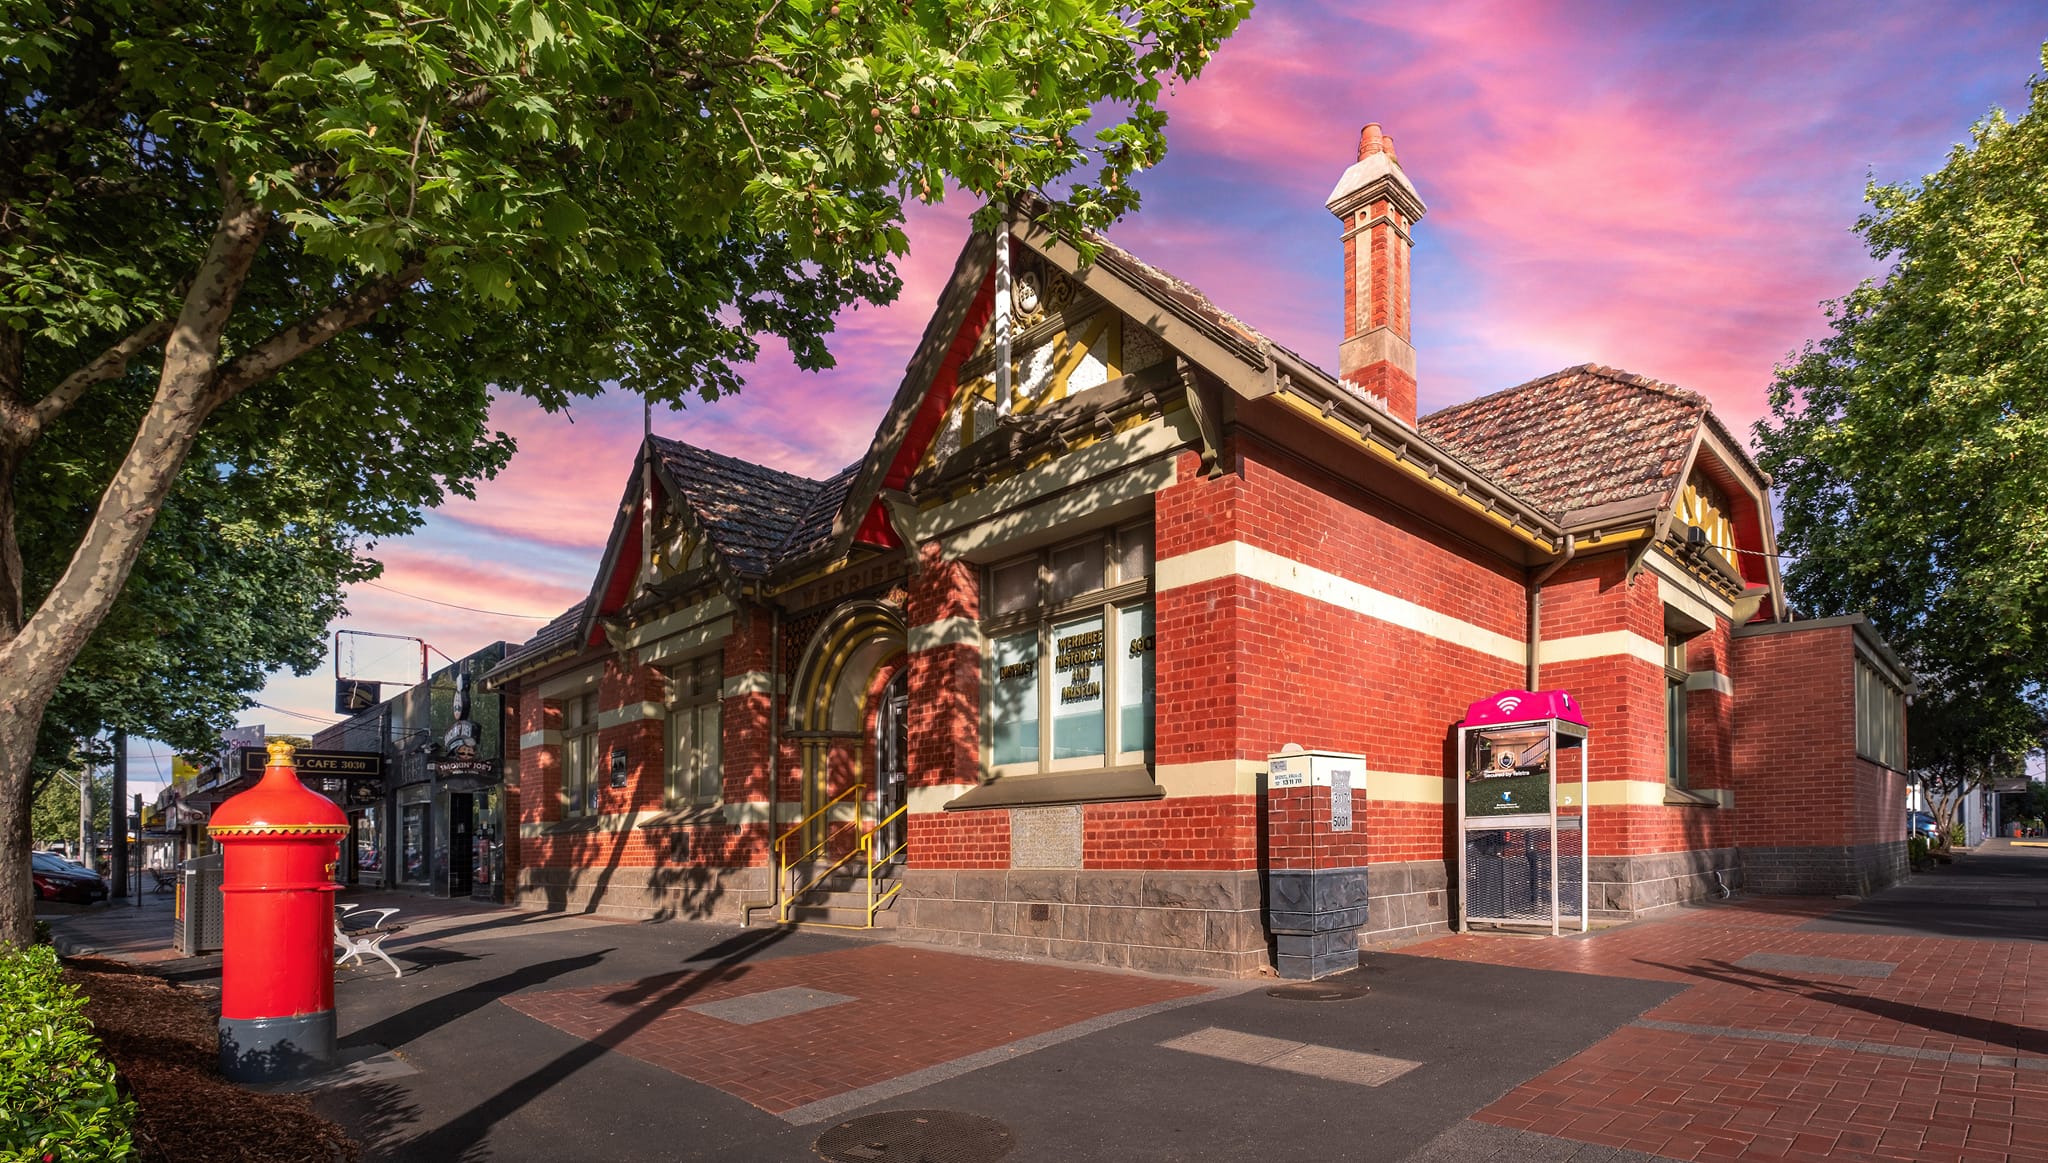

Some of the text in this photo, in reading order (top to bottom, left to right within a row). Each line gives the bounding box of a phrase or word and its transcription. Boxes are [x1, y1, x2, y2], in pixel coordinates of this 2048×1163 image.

[1057, 630, 1103, 651] WERRIBEE
[1071, 666, 1091, 683] AND
[1061, 681, 1101, 700] MUSEUM
[306, 759, 337, 768] CAFE
[341, 761, 366, 769] 3030
